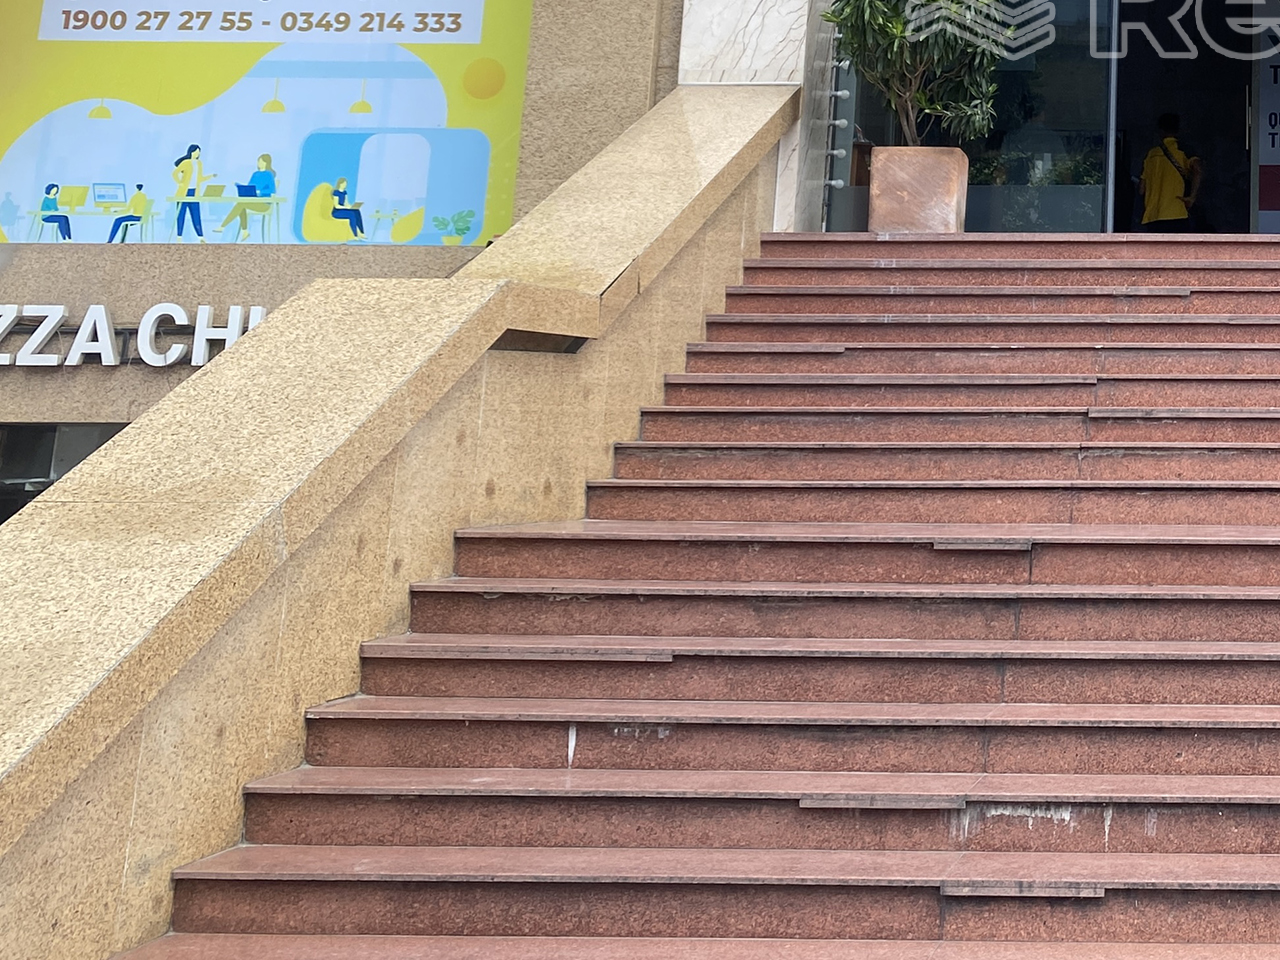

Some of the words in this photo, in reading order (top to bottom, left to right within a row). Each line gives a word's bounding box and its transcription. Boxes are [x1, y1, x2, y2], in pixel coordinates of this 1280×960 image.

[61, 10, 127, 30] 1900
[135, 11, 170, 30] 27
[177, 11, 212, 30] 27
[219, 12, 252, 31] 55
[280, 12, 350, 32] 0349
[359, 13, 405, 32] 214
[412, 13, 462, 32] 333
